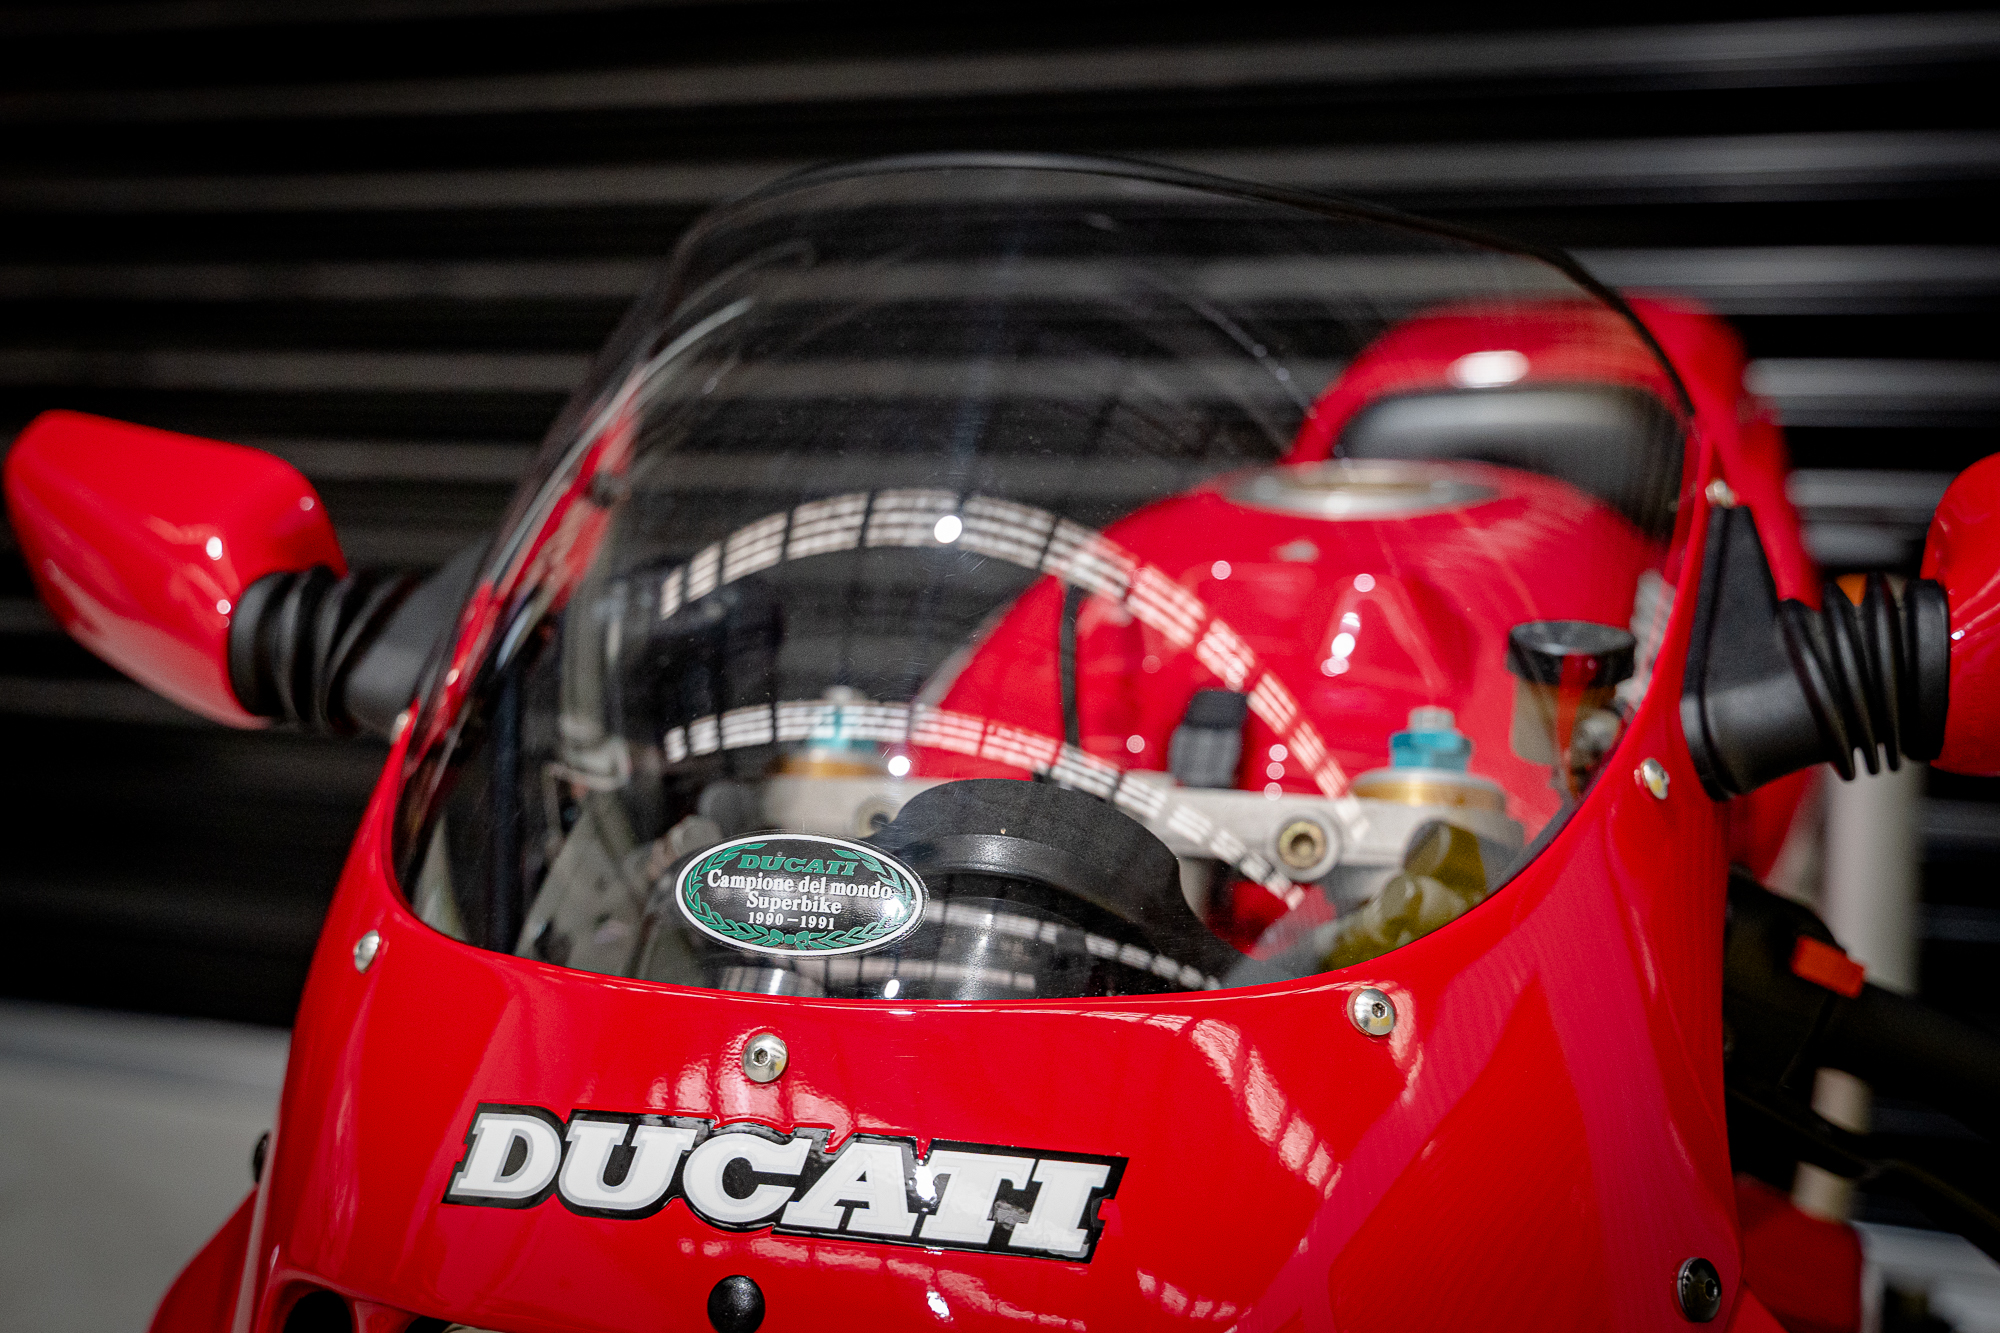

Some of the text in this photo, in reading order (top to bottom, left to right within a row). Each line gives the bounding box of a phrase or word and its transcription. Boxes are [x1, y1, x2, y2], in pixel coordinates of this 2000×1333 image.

[738, 854, 858, 876] DUCATI
[707, 869, 892, 899] Campione del mondo
[746, 891, 842, 914] Superbike
[448, 1112, 1113, 1252] DUCATI
